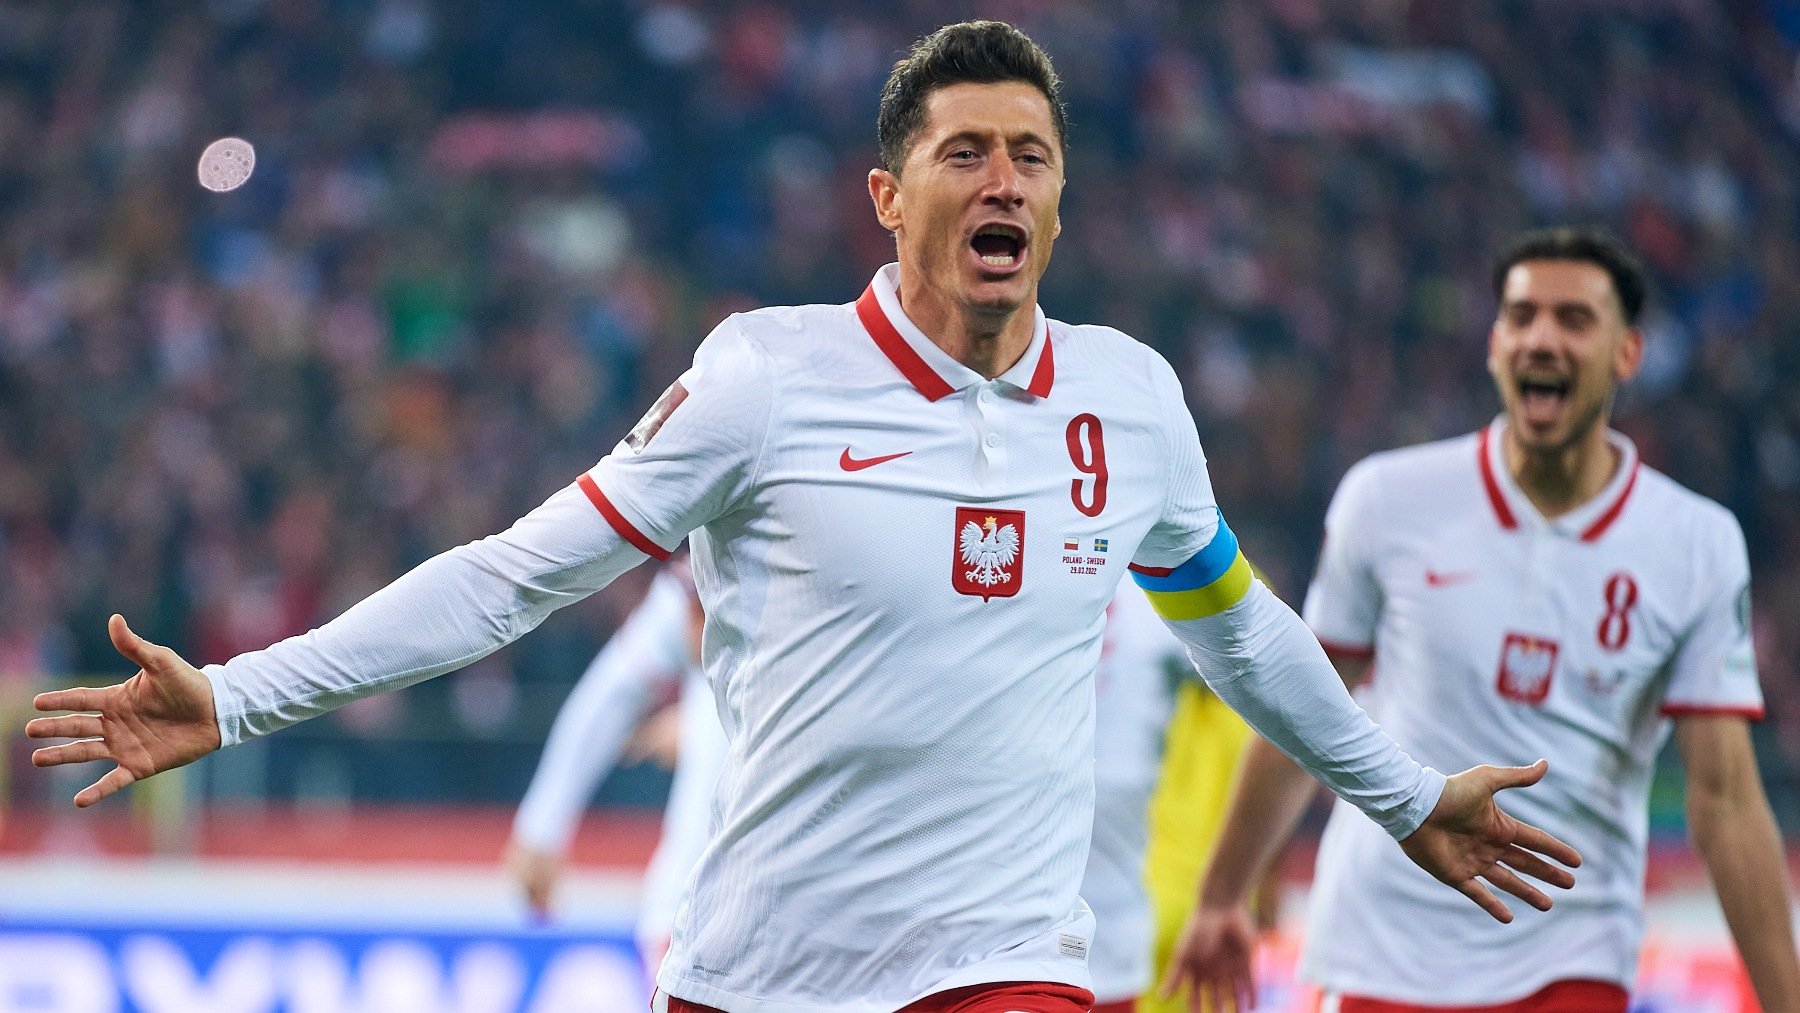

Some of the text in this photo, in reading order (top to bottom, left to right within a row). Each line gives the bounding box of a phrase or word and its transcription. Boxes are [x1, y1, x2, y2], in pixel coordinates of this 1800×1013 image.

[1066, 413, 1108, 517] 9
[1062, 556, 1082, 564] POLAND
[1087, 557, 1106, 565] SWEDEN
[1070, 566, 1097, 575] 29.03.2022
[1597, 571, 1638, 654] 8
